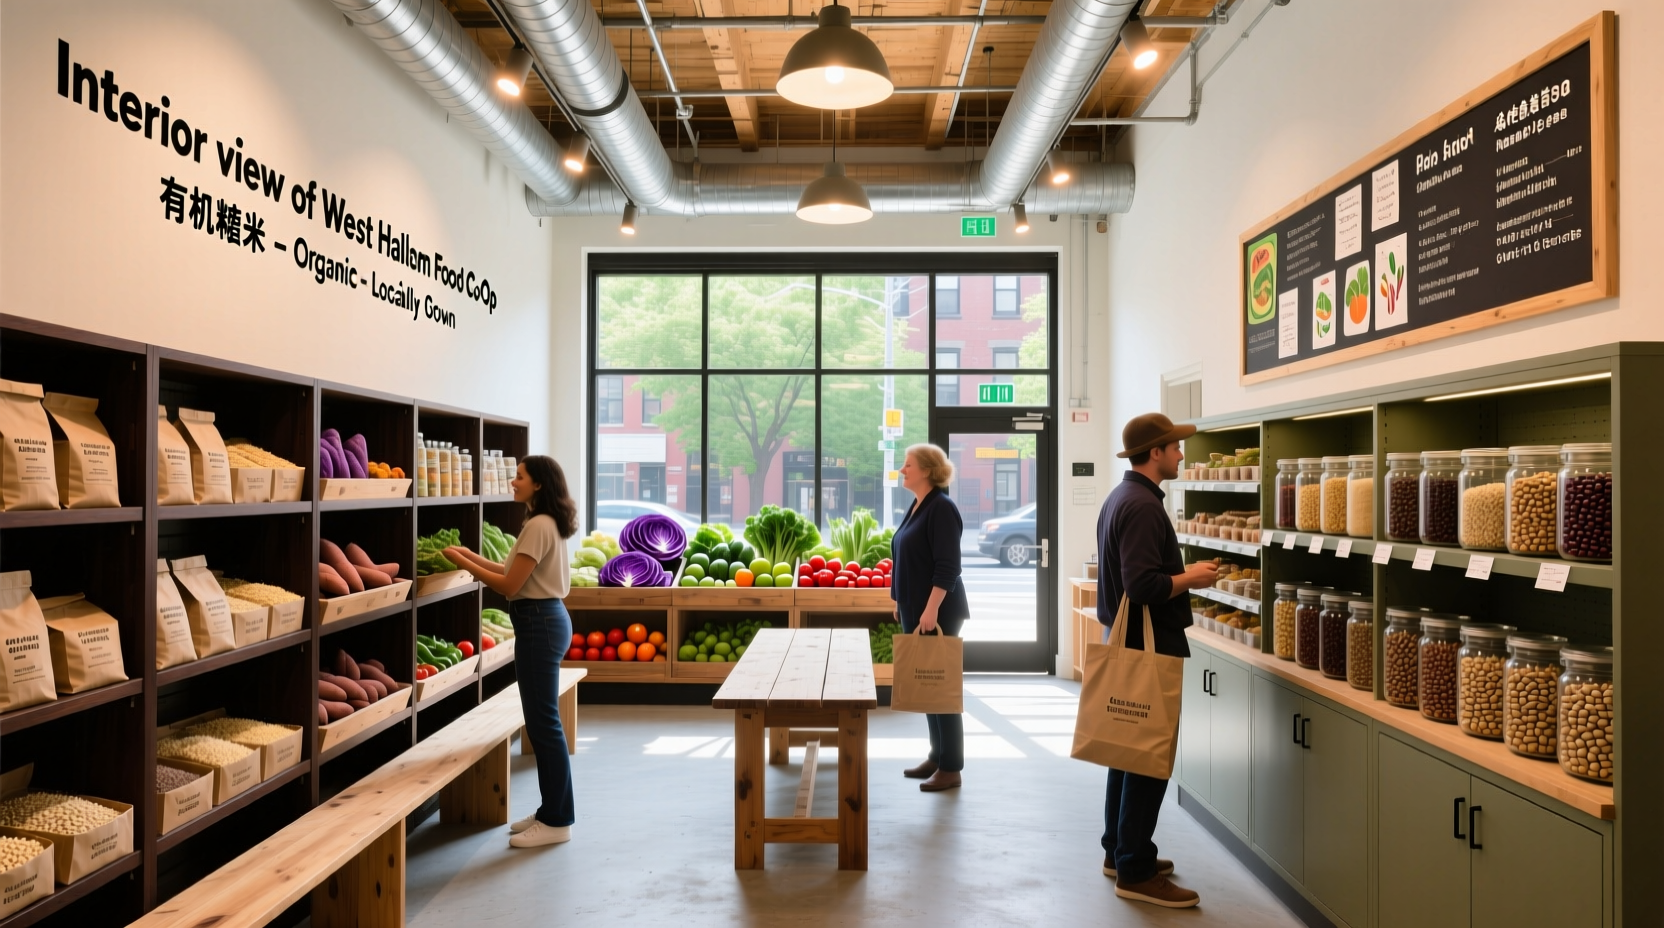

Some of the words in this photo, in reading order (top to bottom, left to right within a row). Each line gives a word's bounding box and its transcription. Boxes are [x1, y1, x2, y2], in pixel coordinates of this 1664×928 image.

[57, 37, 208, 164] Interior
[216, 136, 285, 203] view
[291, 180, 317, 220] of
[322, 187, 374, 249] West
[434, 252, 464, 293] Food
[294, 237, 358, 289] Organic
